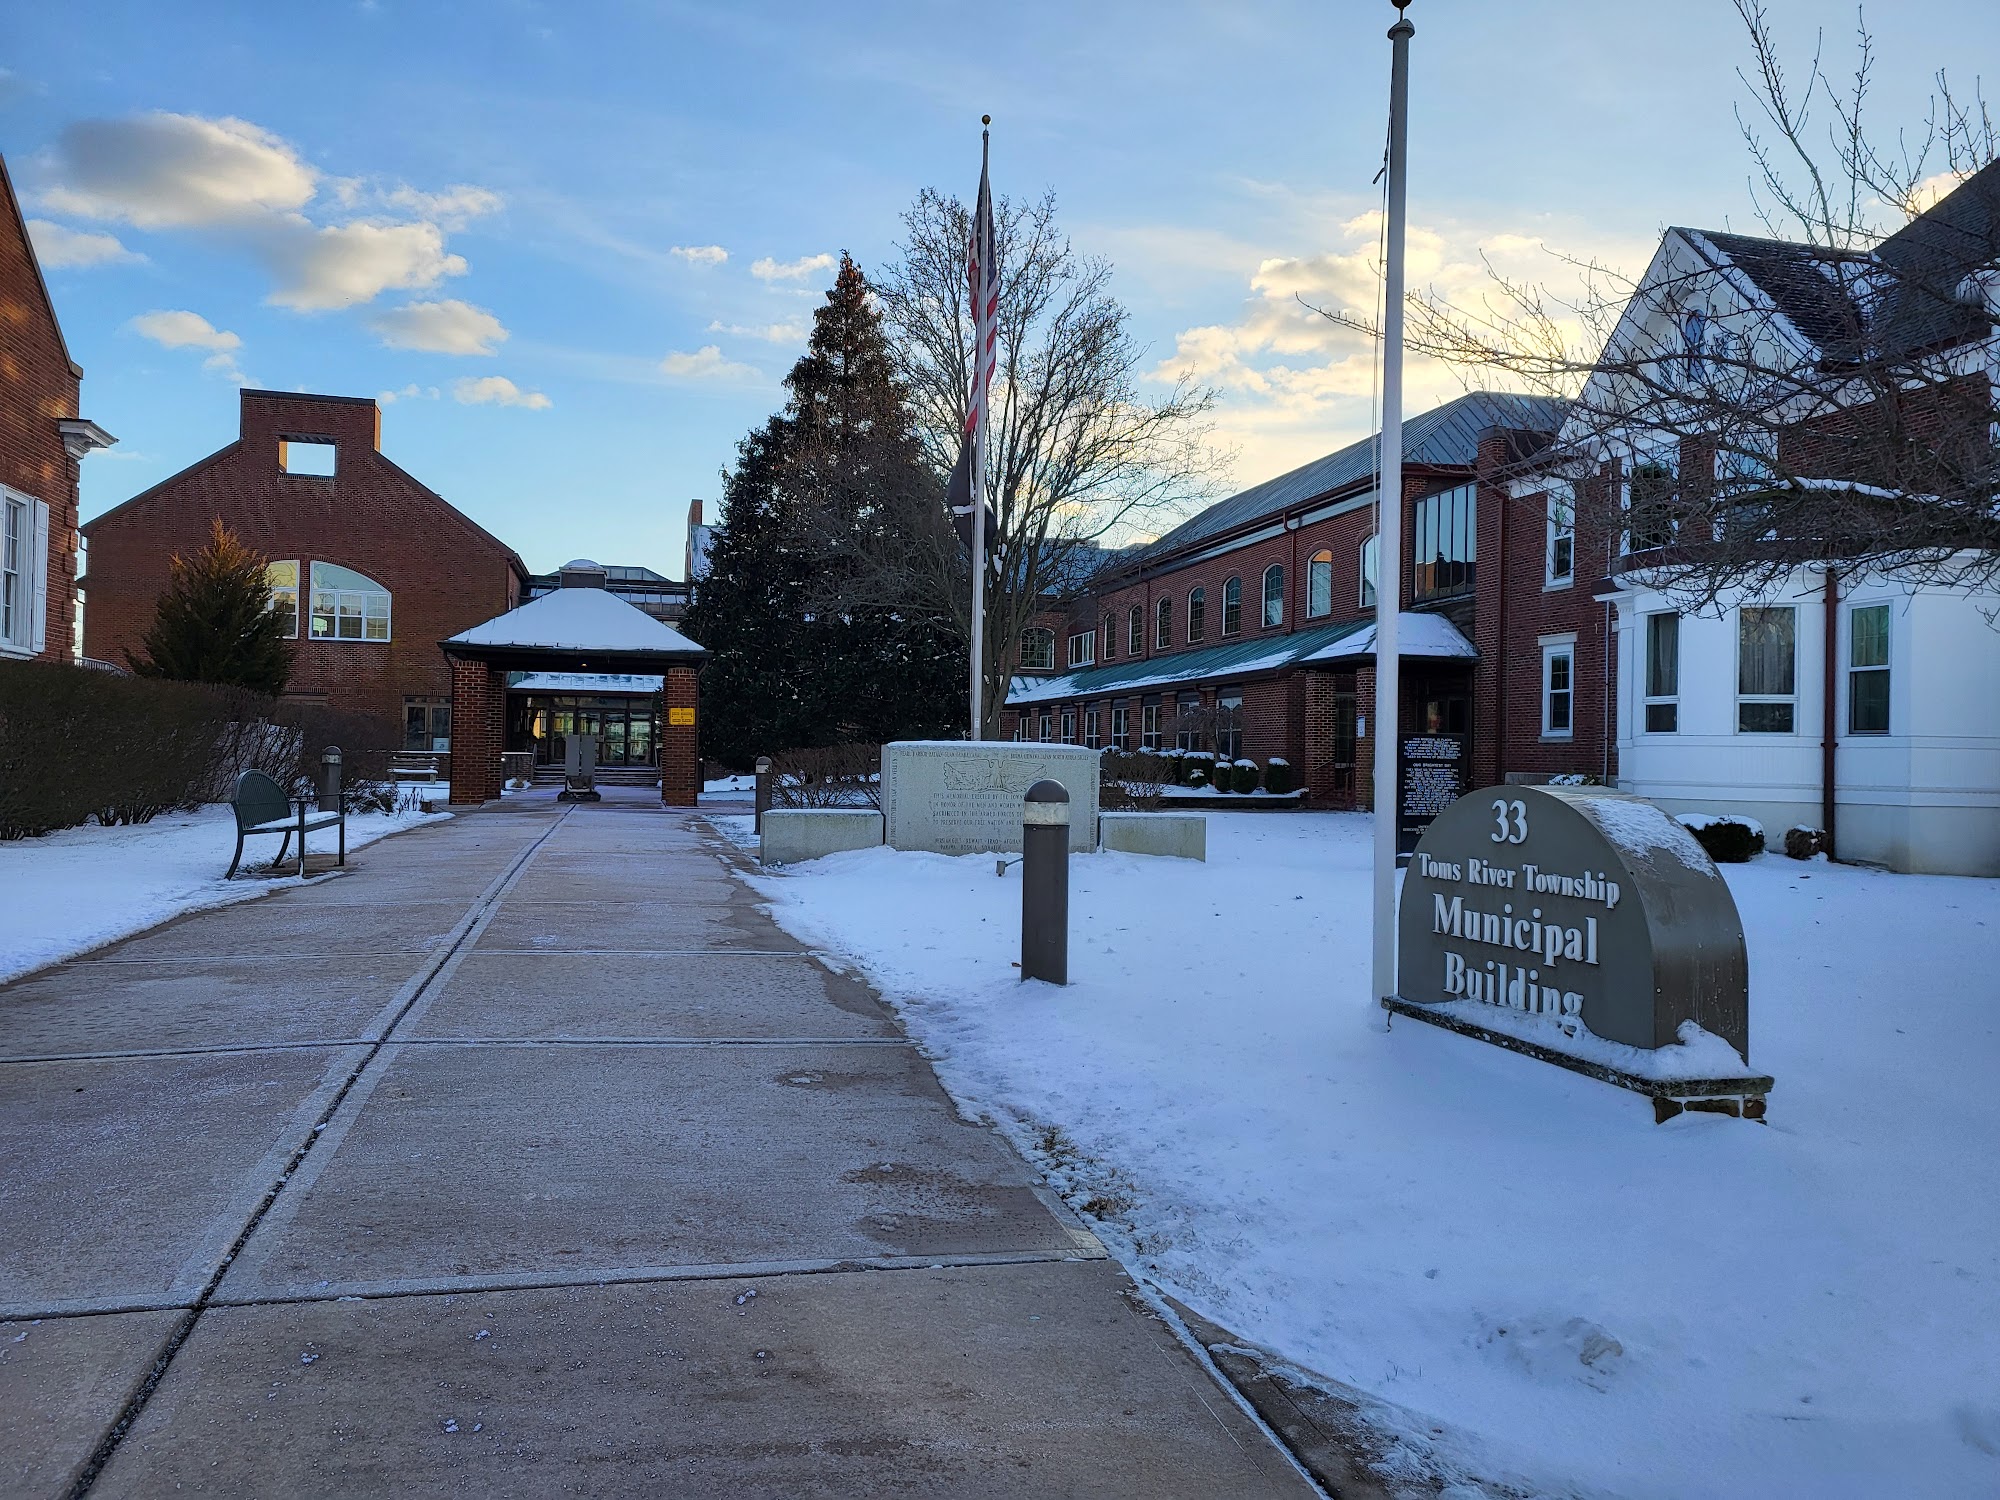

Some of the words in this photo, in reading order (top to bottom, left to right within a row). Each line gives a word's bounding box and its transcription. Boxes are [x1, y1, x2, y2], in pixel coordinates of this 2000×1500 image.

[1491, 800, 1528, 844] 33
[1418, 853, 1462, 882] Toms
[1468, 858, 1517, 889] River
[1523, 863, 1621, 909] Township
[1432, 893, 1600, 967] Municipal
[1443, 951, 1585, 1020] Building
